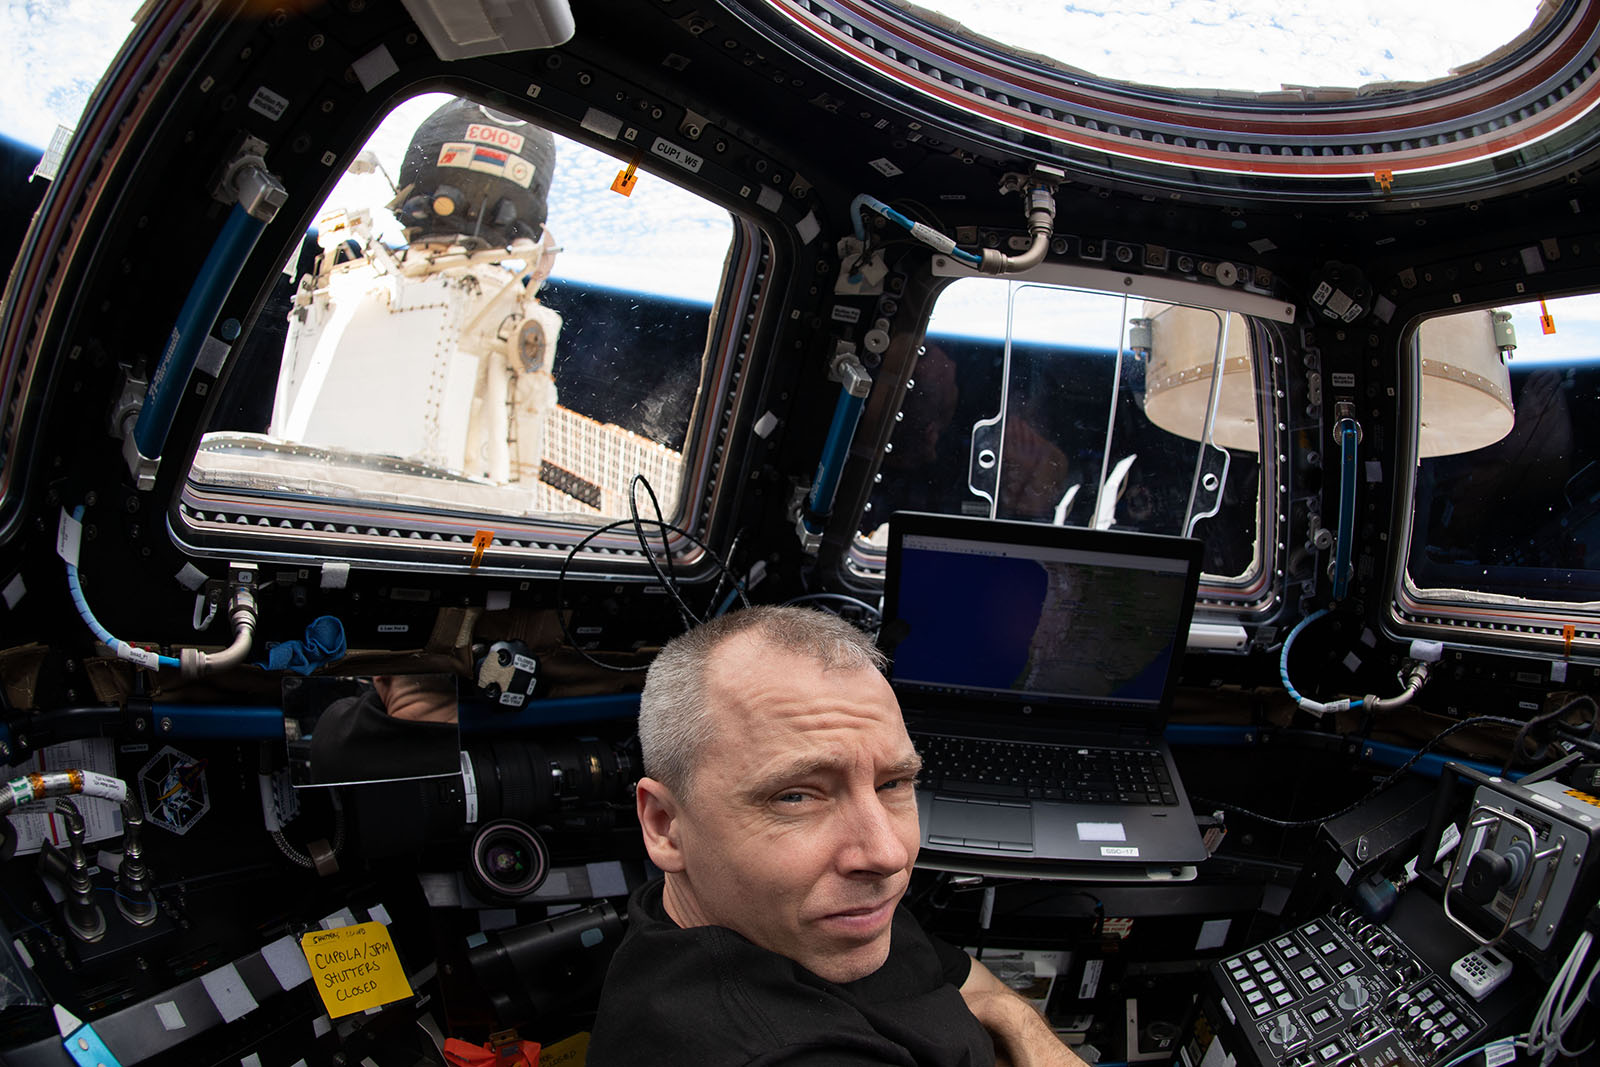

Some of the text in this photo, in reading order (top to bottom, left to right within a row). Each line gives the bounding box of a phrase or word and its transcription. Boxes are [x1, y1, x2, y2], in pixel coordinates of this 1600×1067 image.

[469, 126, 520, 150] СОЮЗ
[656, 142, 699, 168] CUP1_W5
[315, 942, 391, 970] CUPOLA/JPM
[324, 960, 381, 988] SHUTTERS
[336, 980, 378, 1001] CLOSED
